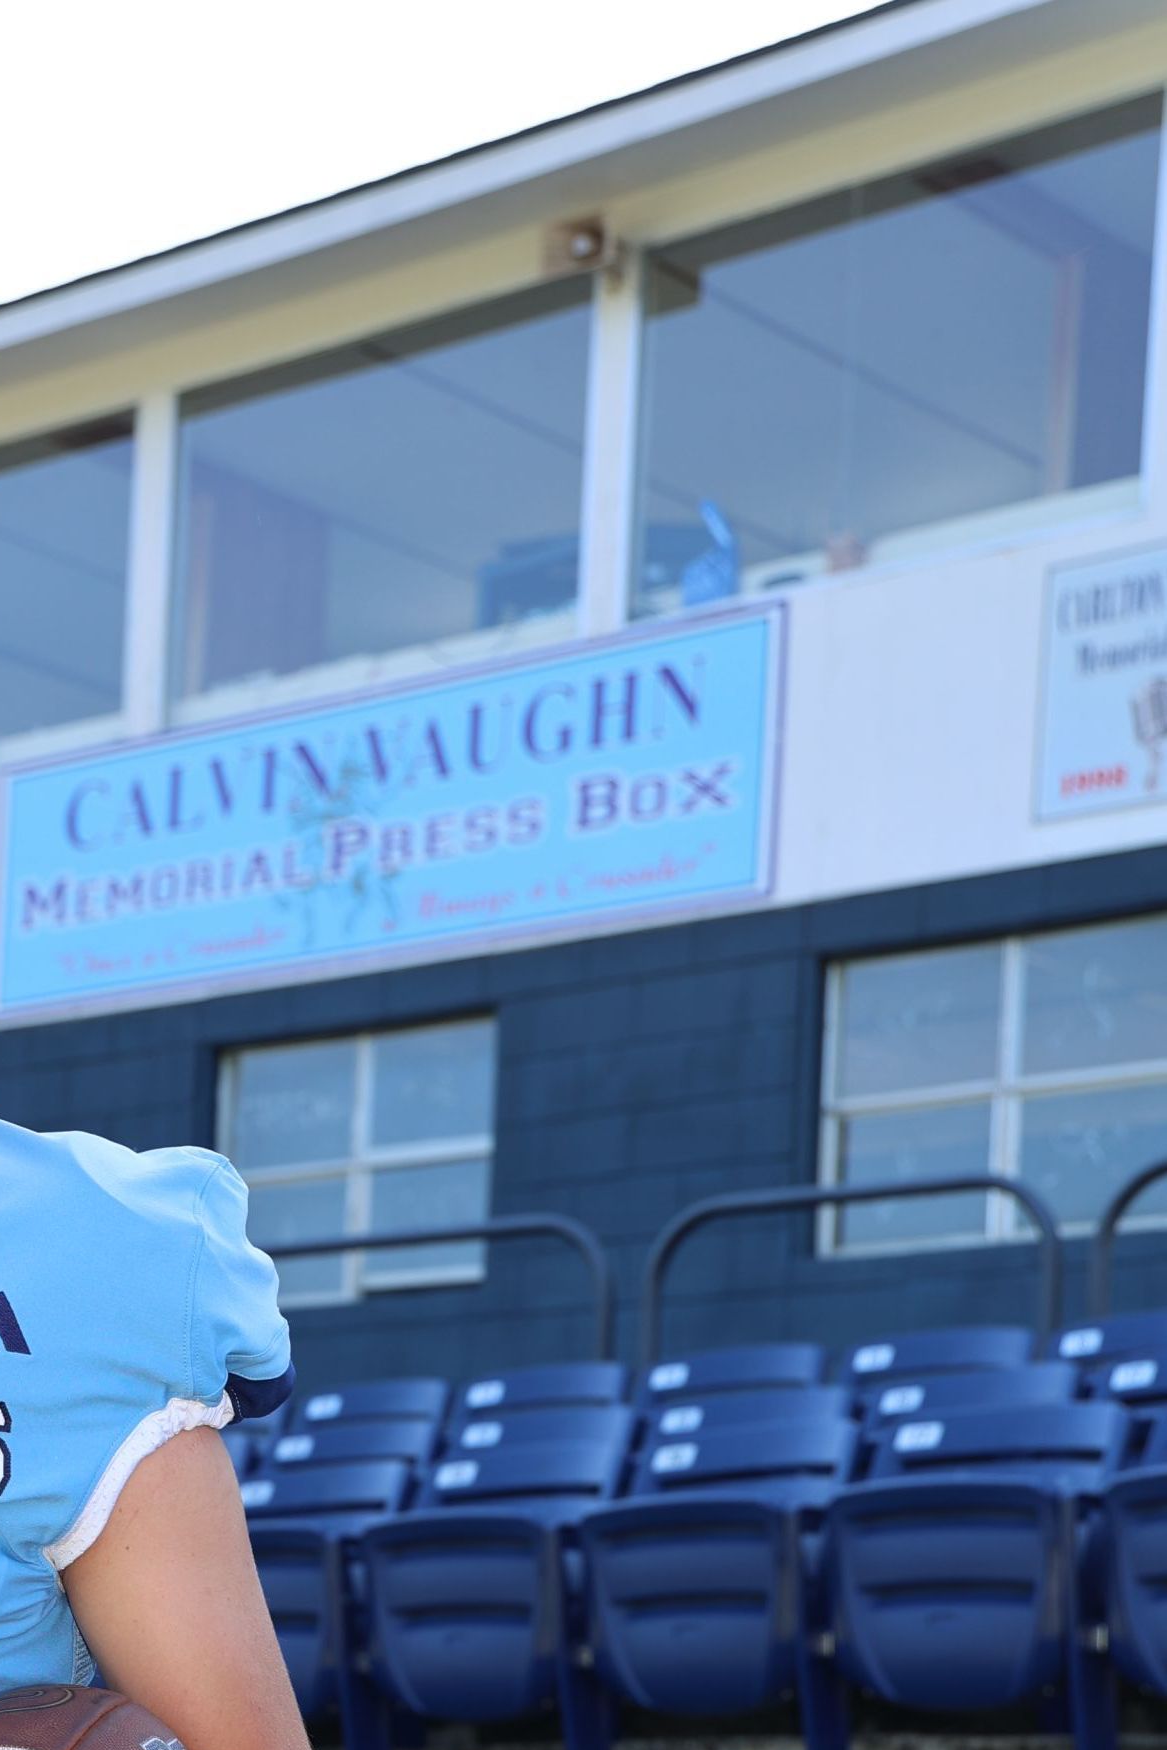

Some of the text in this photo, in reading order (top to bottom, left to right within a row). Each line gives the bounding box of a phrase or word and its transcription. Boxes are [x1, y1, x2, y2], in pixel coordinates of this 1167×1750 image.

[63, 654, 707, 853] CALVIN VAUGHN
[21, 836, 318, 932] MEMORIAL
[325, 800, 543, 878] PRESS
